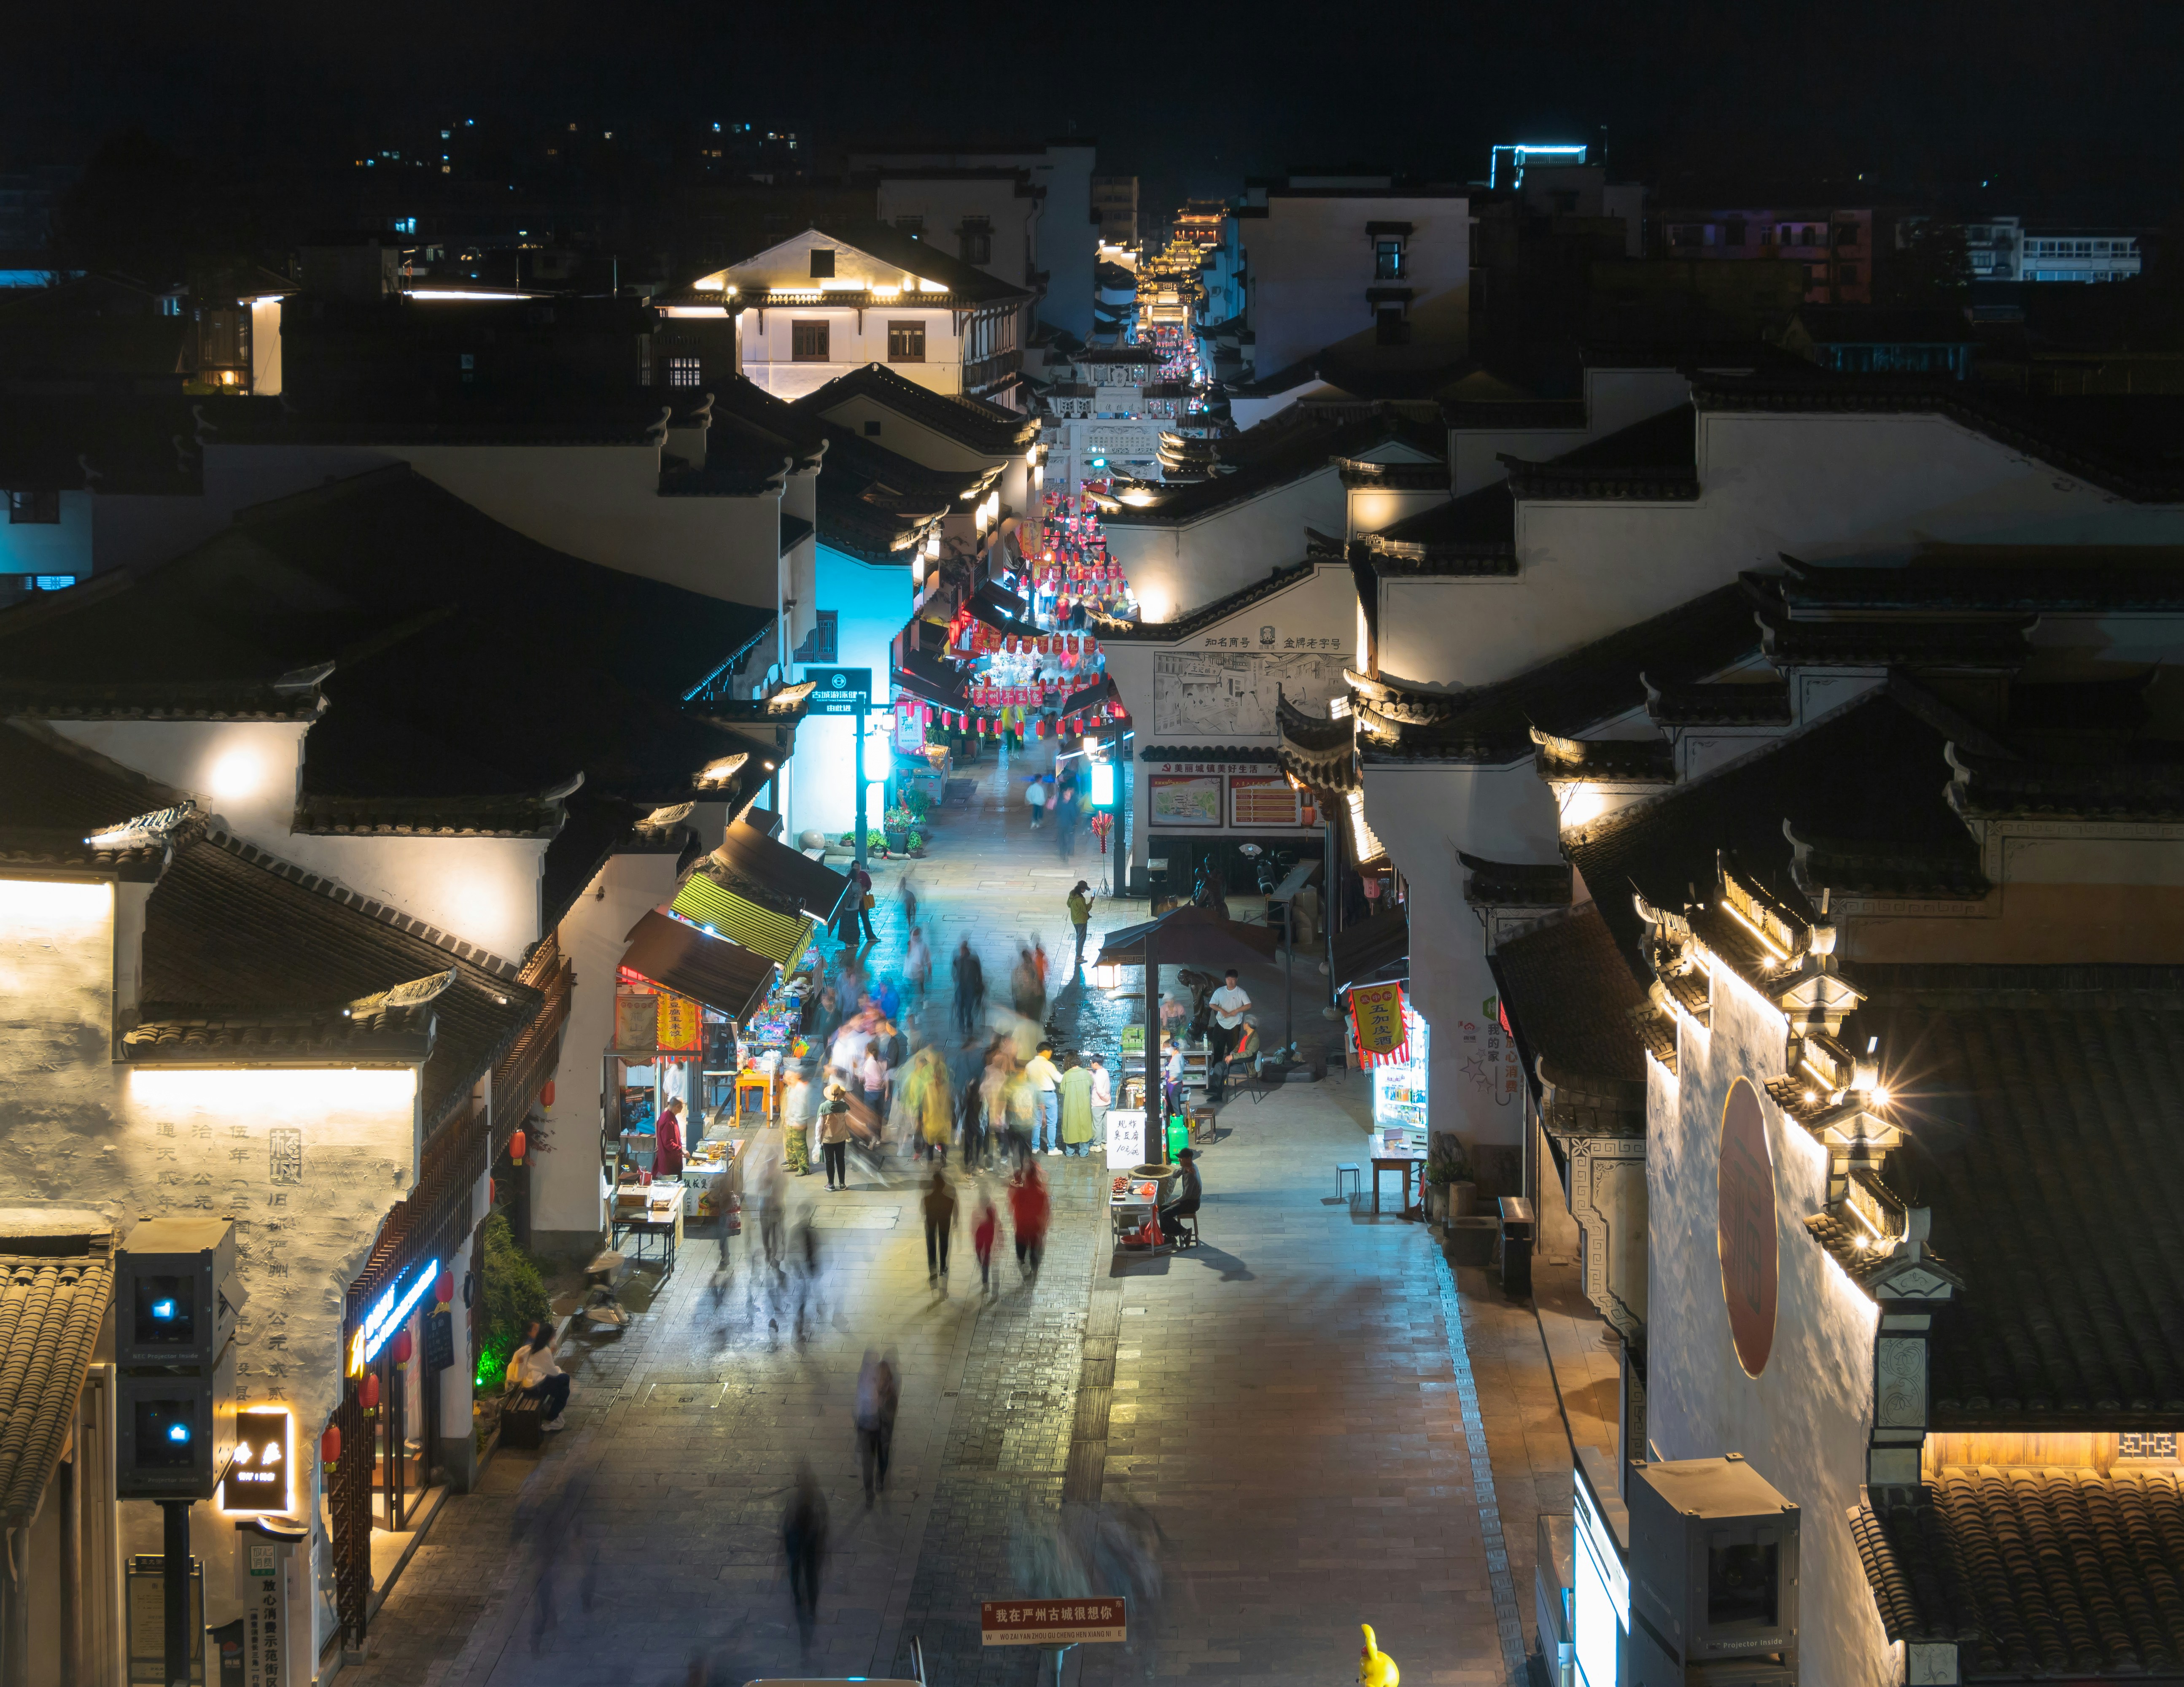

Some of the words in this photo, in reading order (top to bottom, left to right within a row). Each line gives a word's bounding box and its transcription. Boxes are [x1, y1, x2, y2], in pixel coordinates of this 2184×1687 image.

[1206, 637, 1250, 648] 知名商号
[1284, 637, 1341, 650] 金牌老字号
[1175, 763, 1258, 773] 美丽城镇美好生活
[1369, 1004, 1393, 1046] 五加皮酒
[1488, 1024, 1500, 1062] 我的家
[1118, 1119, 1137, 1129] 现炸
[1114, 1129, 1139, 1141] 臭豆腐
[270, 1129, 302, 1183] 梅城
[996, 1606, 1112, 1622] 我在严州古城很想你
[262, 1579, 279, 1687] 放心消费示范街区
[1723, 1641, 1758, 1649] Projector
[1760, 1638, 1783, 1646] Inside
